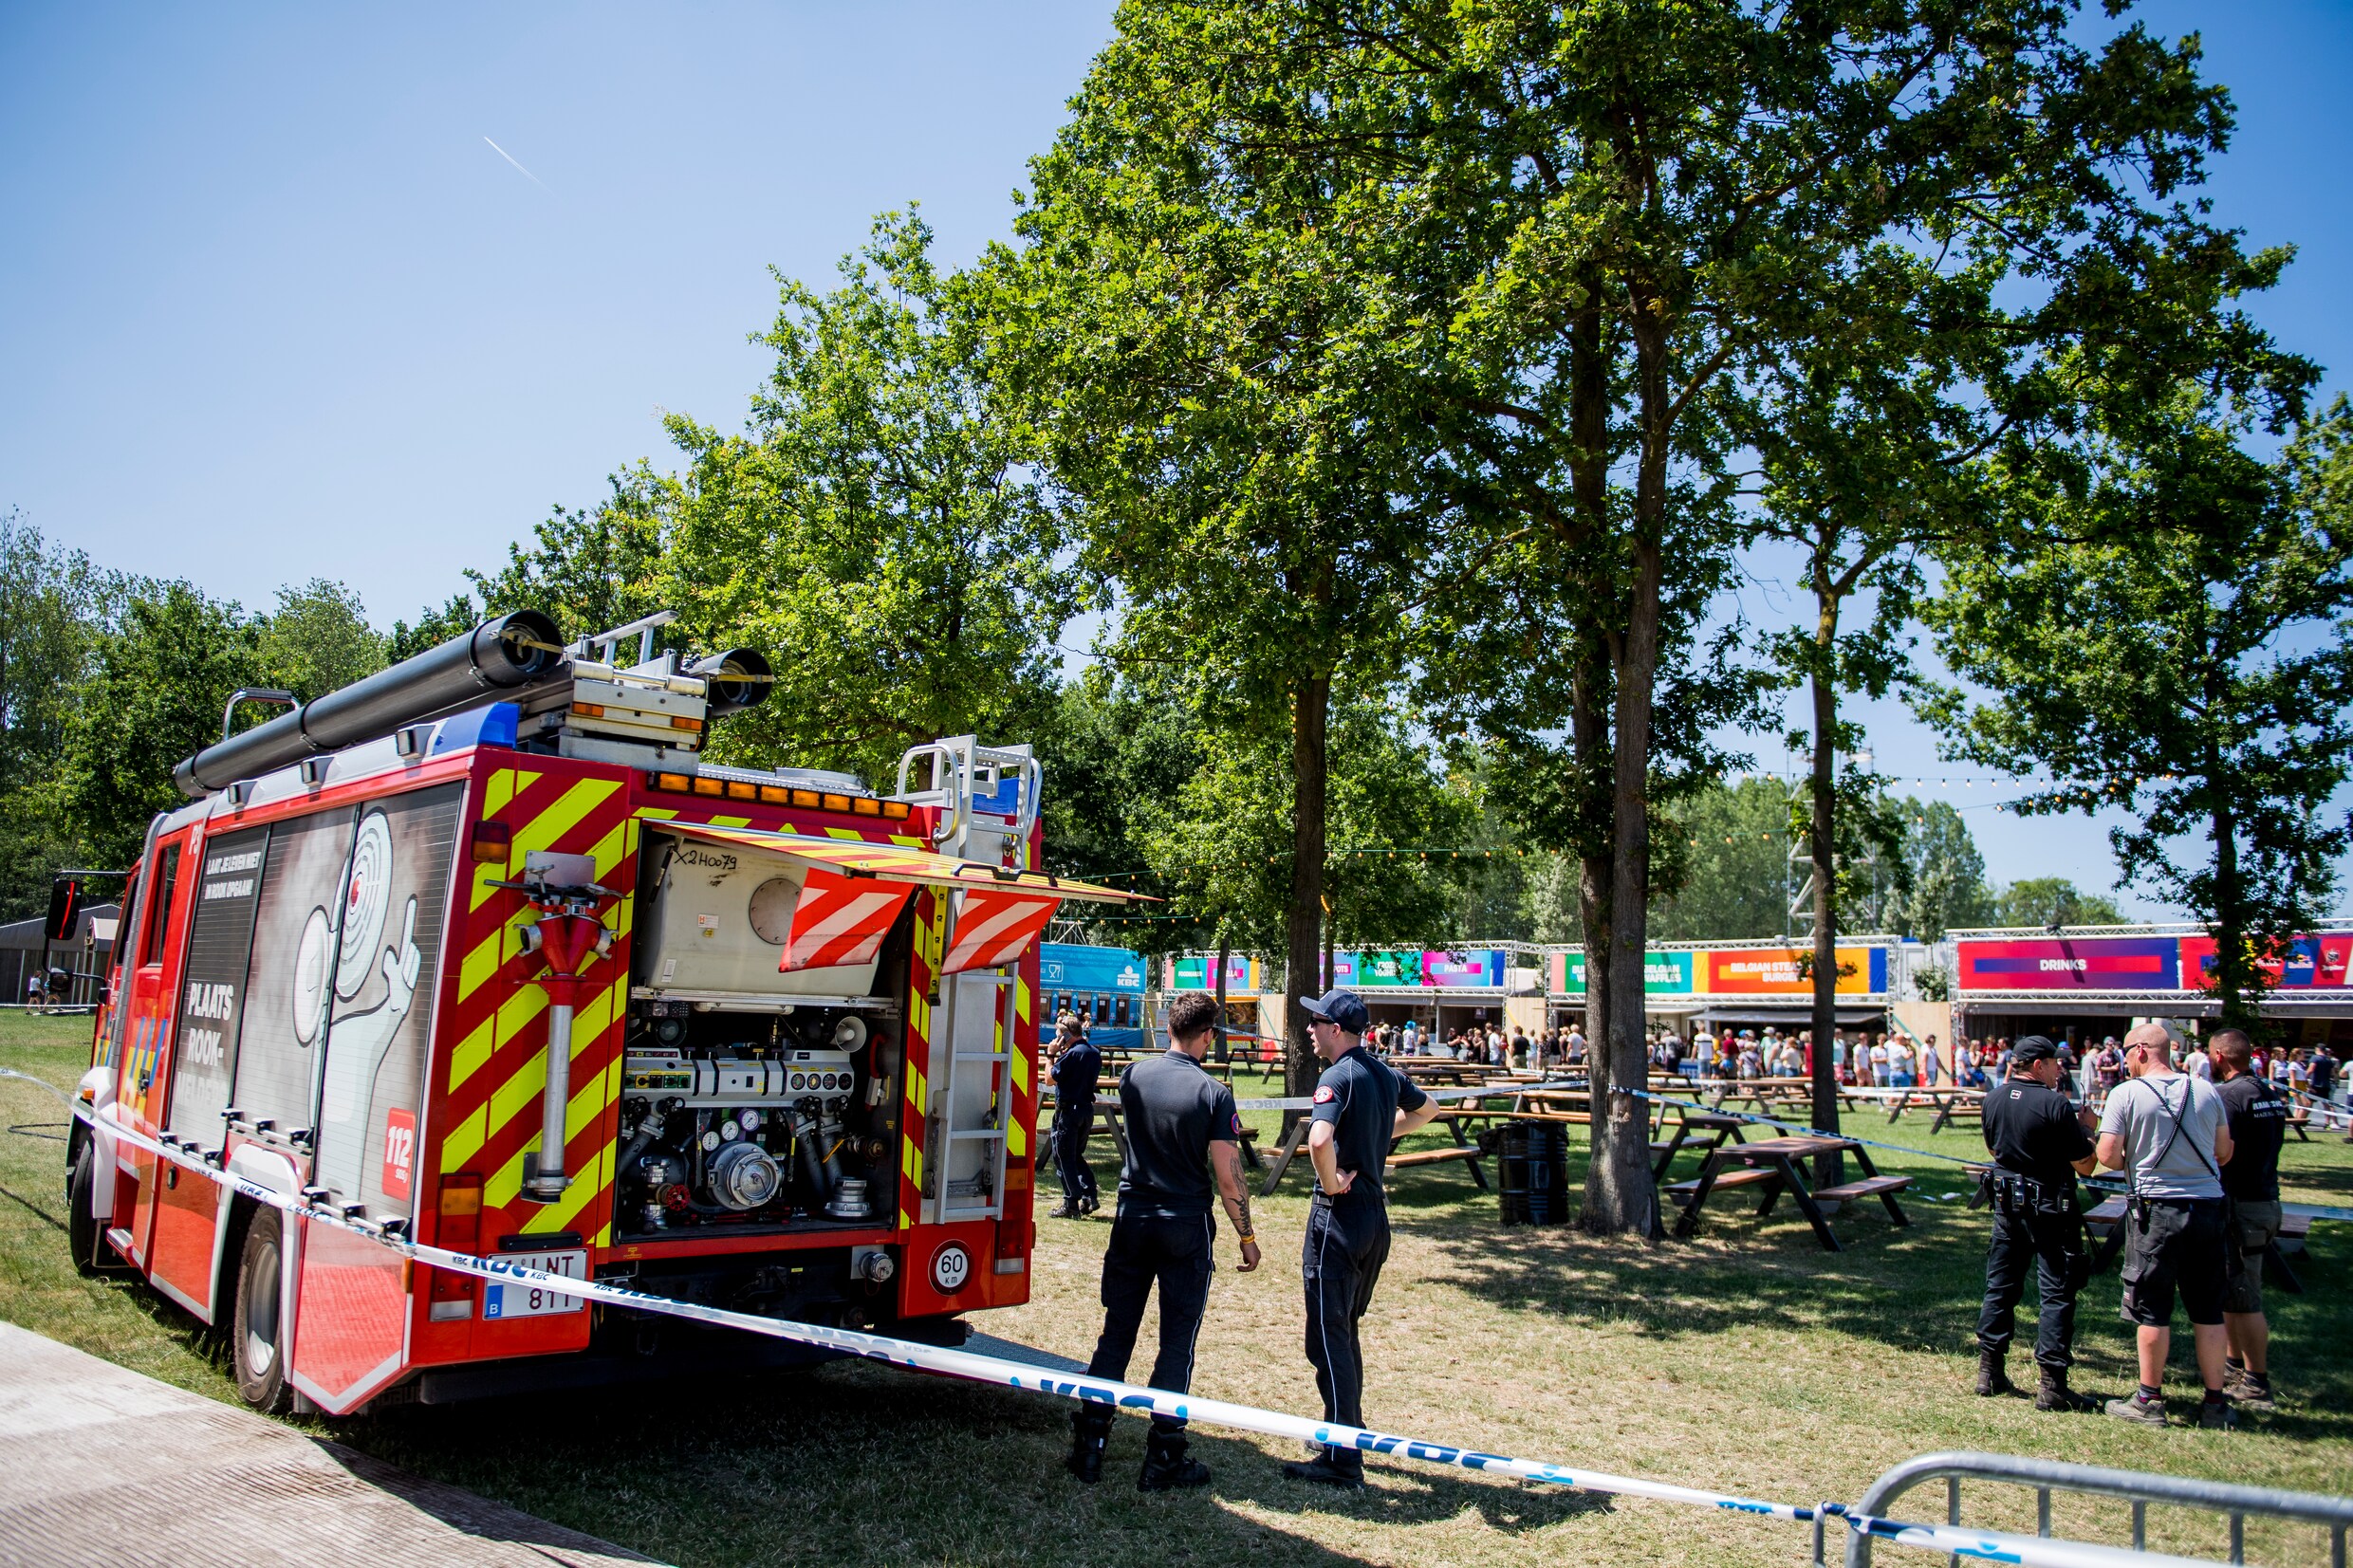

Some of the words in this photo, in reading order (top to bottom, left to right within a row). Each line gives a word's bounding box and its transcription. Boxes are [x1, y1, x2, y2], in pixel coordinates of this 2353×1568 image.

[1444, 964, 1468, 973] PASTA
[1731, 963, 1771, 972] BELGIAN
[2040, 959, 2087, 970] DRINKS
[1117, 978, 1140, 987] KBC
[188, 983, 234, 1021] PLAATS
[187, 1027, 224, 1066] ROOK-
[386, 1125, 413, 1168] 112
[452, 1255, 468, 1266] KBC
[941, 1254, 963, 1273] 60
[529, 1270, 551, 1281] KBC
[490, 1303, 499, 1315] B
